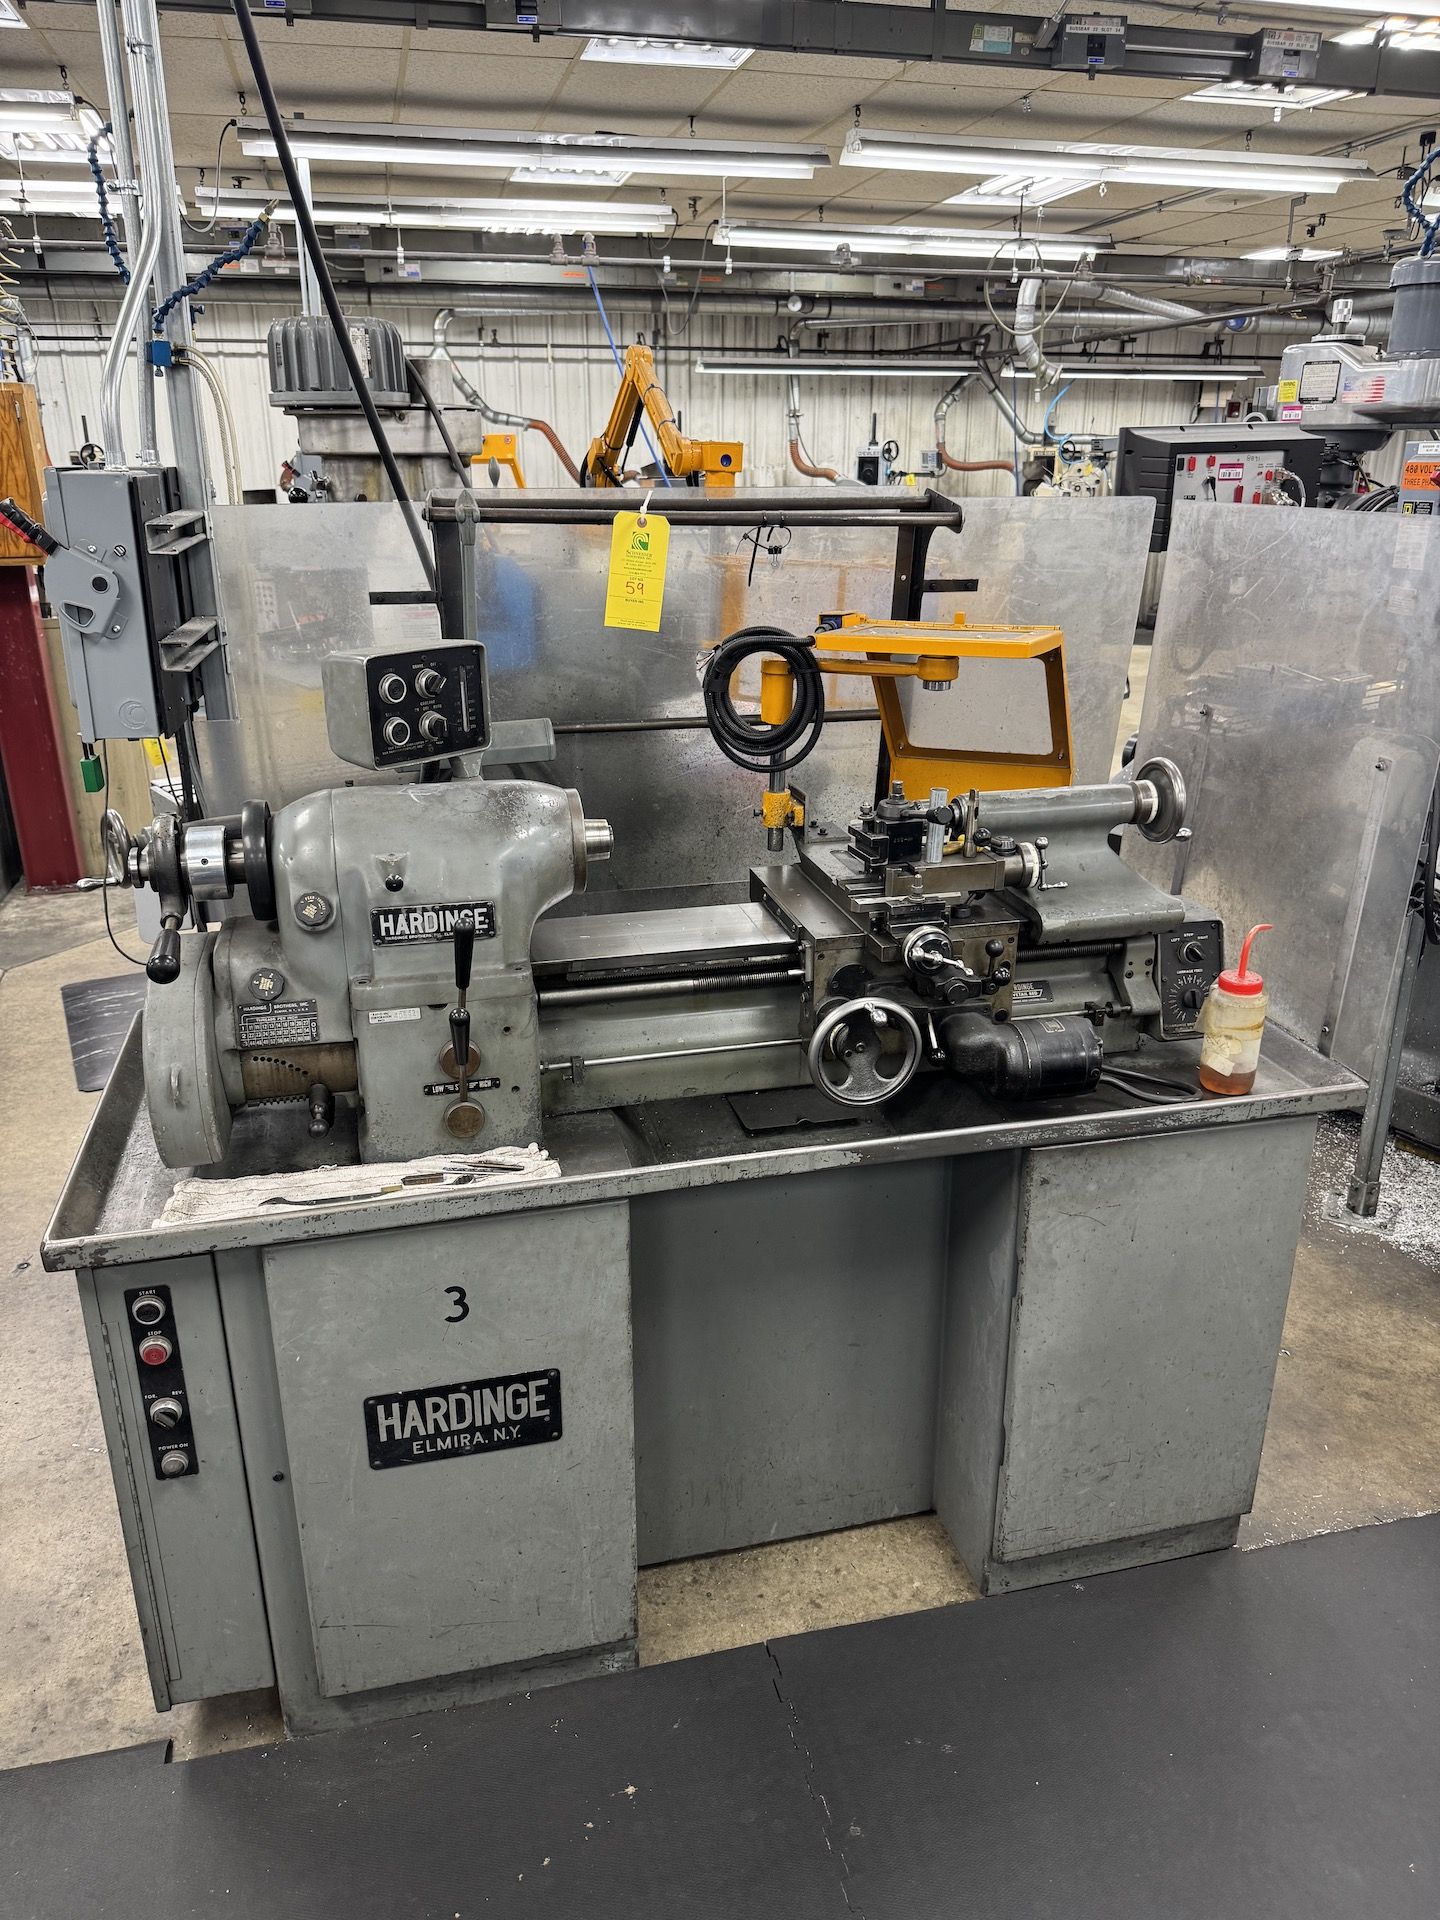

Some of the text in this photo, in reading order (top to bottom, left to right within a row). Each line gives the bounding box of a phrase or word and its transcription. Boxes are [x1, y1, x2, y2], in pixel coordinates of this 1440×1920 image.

[1420, 465, 1440, 473] VOLT
[626, 581, 644, 595] 59
[444, 1286, 470, 1323] 3
[376, 1379, 550, 1442] HARDINGE
[494, 1425, 522, 1440] N.Y.
